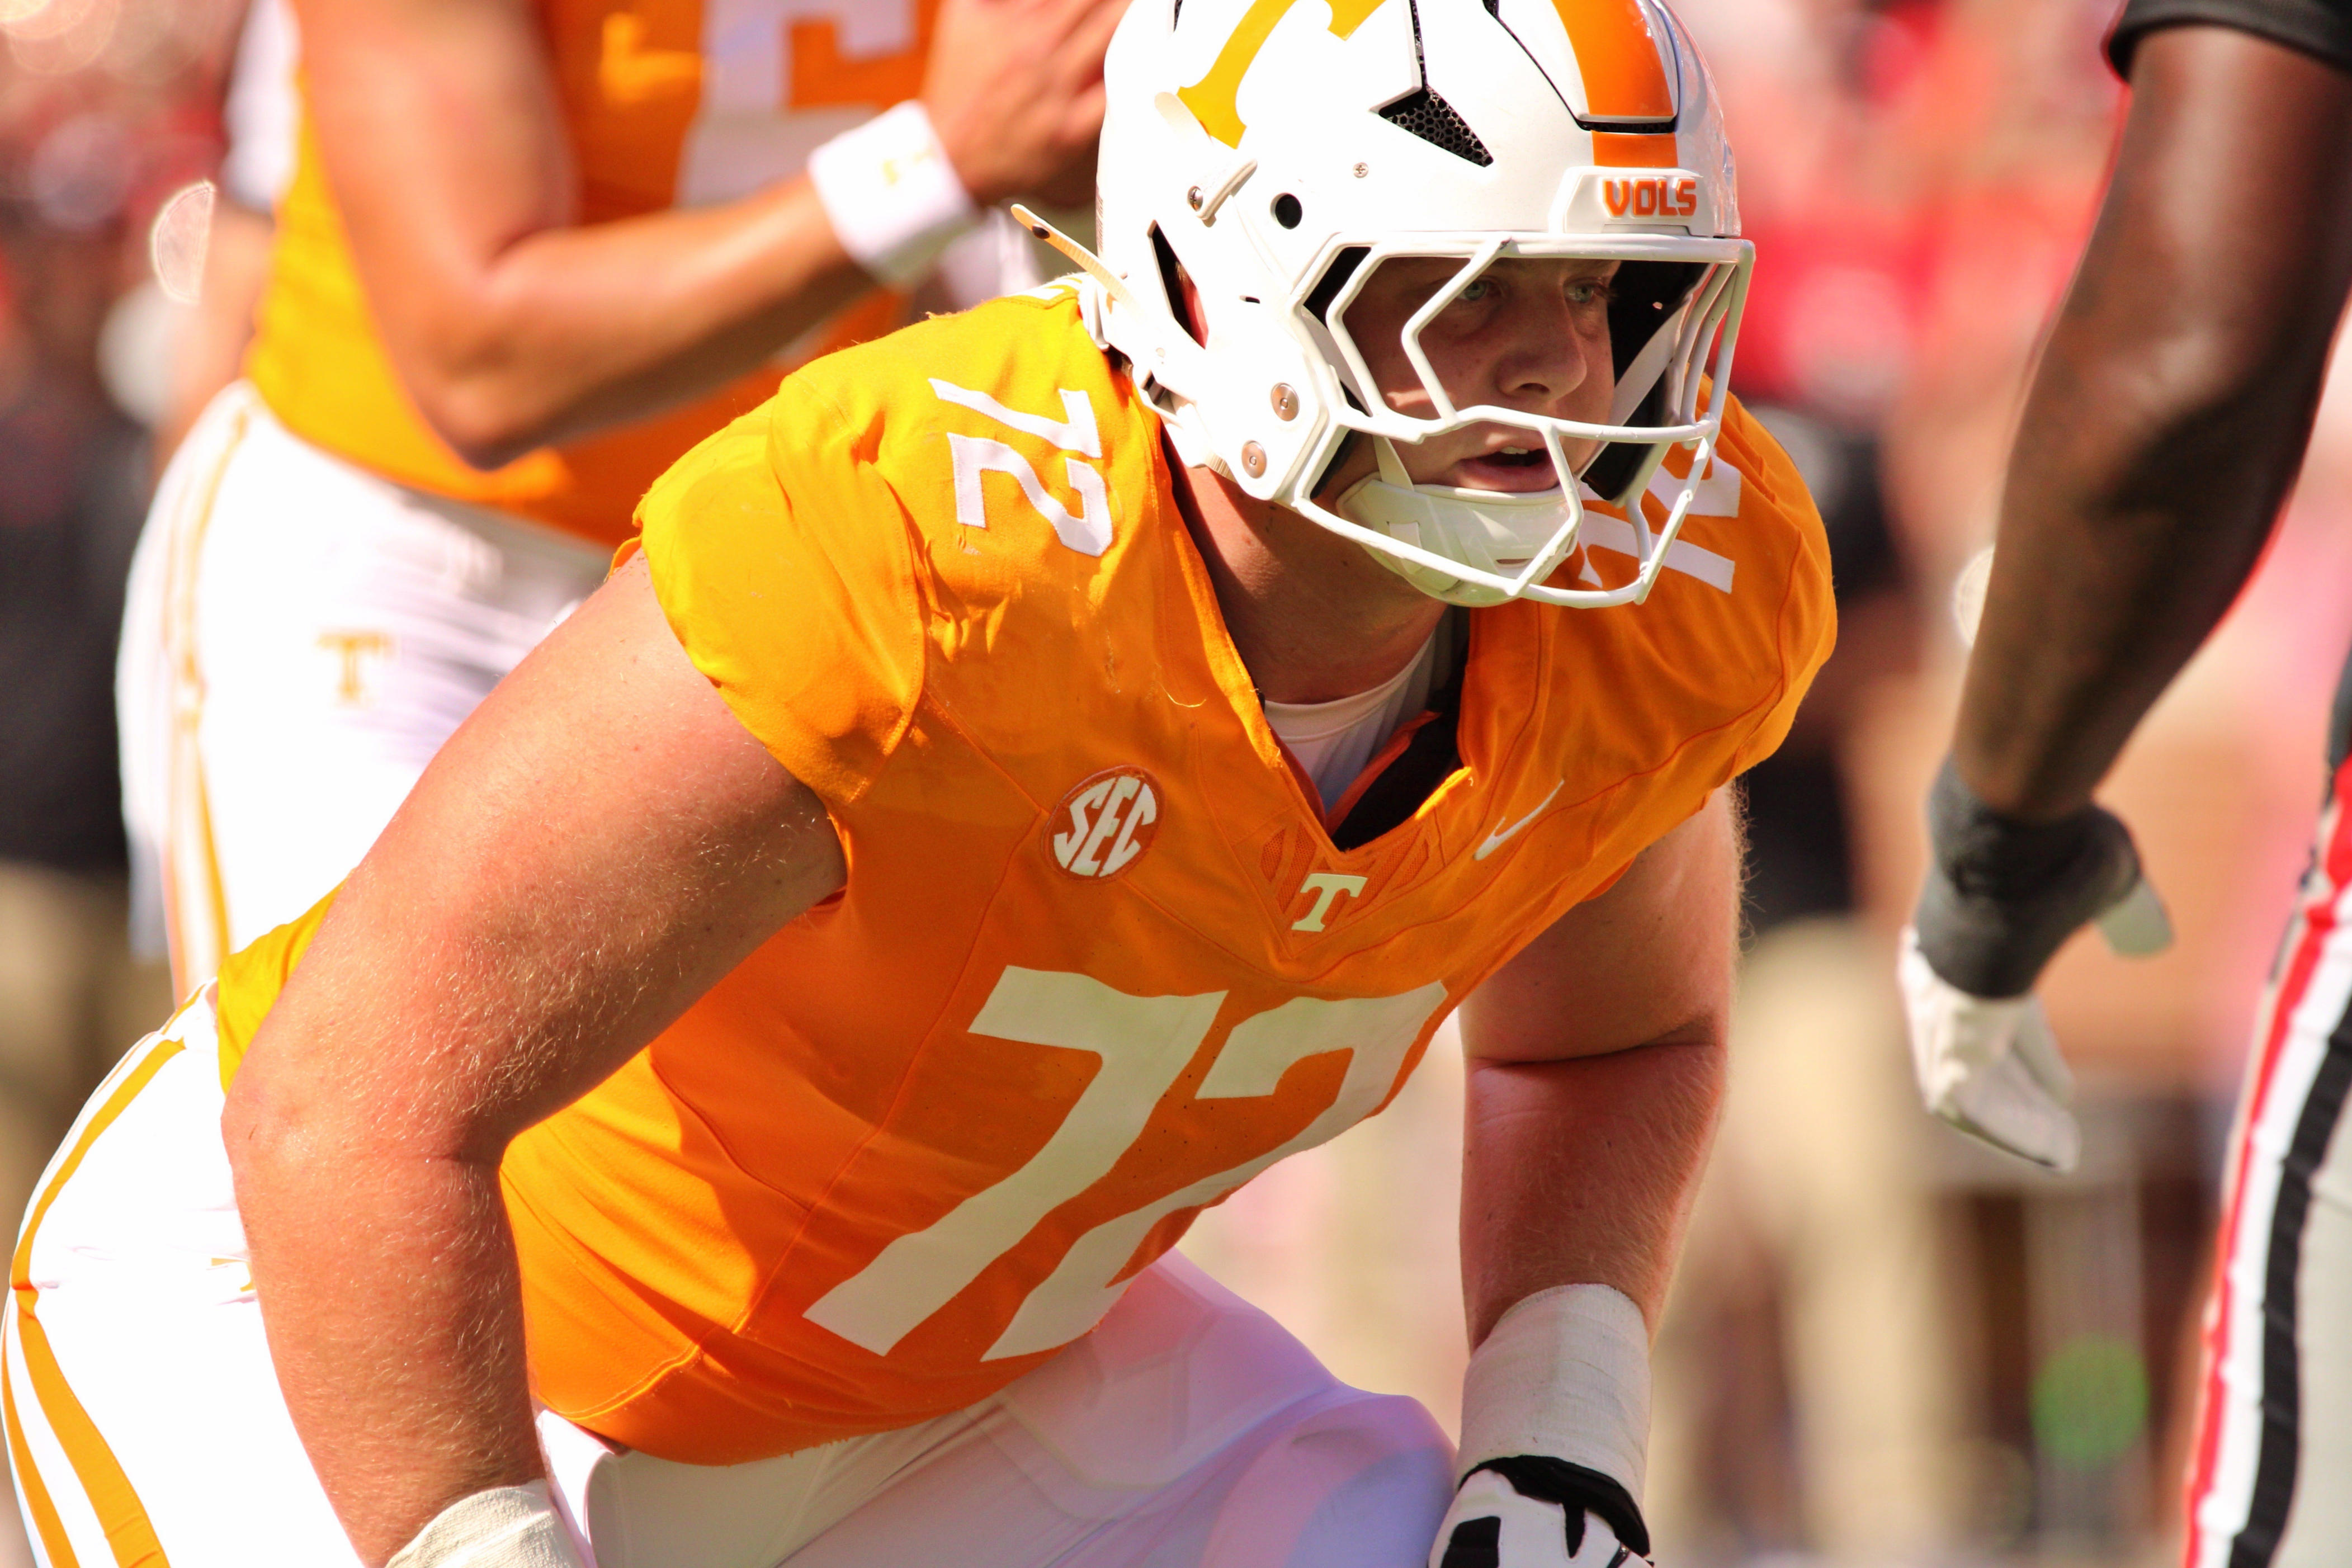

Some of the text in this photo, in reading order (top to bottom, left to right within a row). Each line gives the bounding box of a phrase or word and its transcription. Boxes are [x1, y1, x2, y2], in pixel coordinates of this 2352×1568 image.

[1603, 180, 1697, 216] VOLS
[928, 377, 1113, 557] 72
[1054, 776, 1156, 877] SEC
[1291, 873, 1368, 933] T
[802, 965, 1448, 1363] 72
